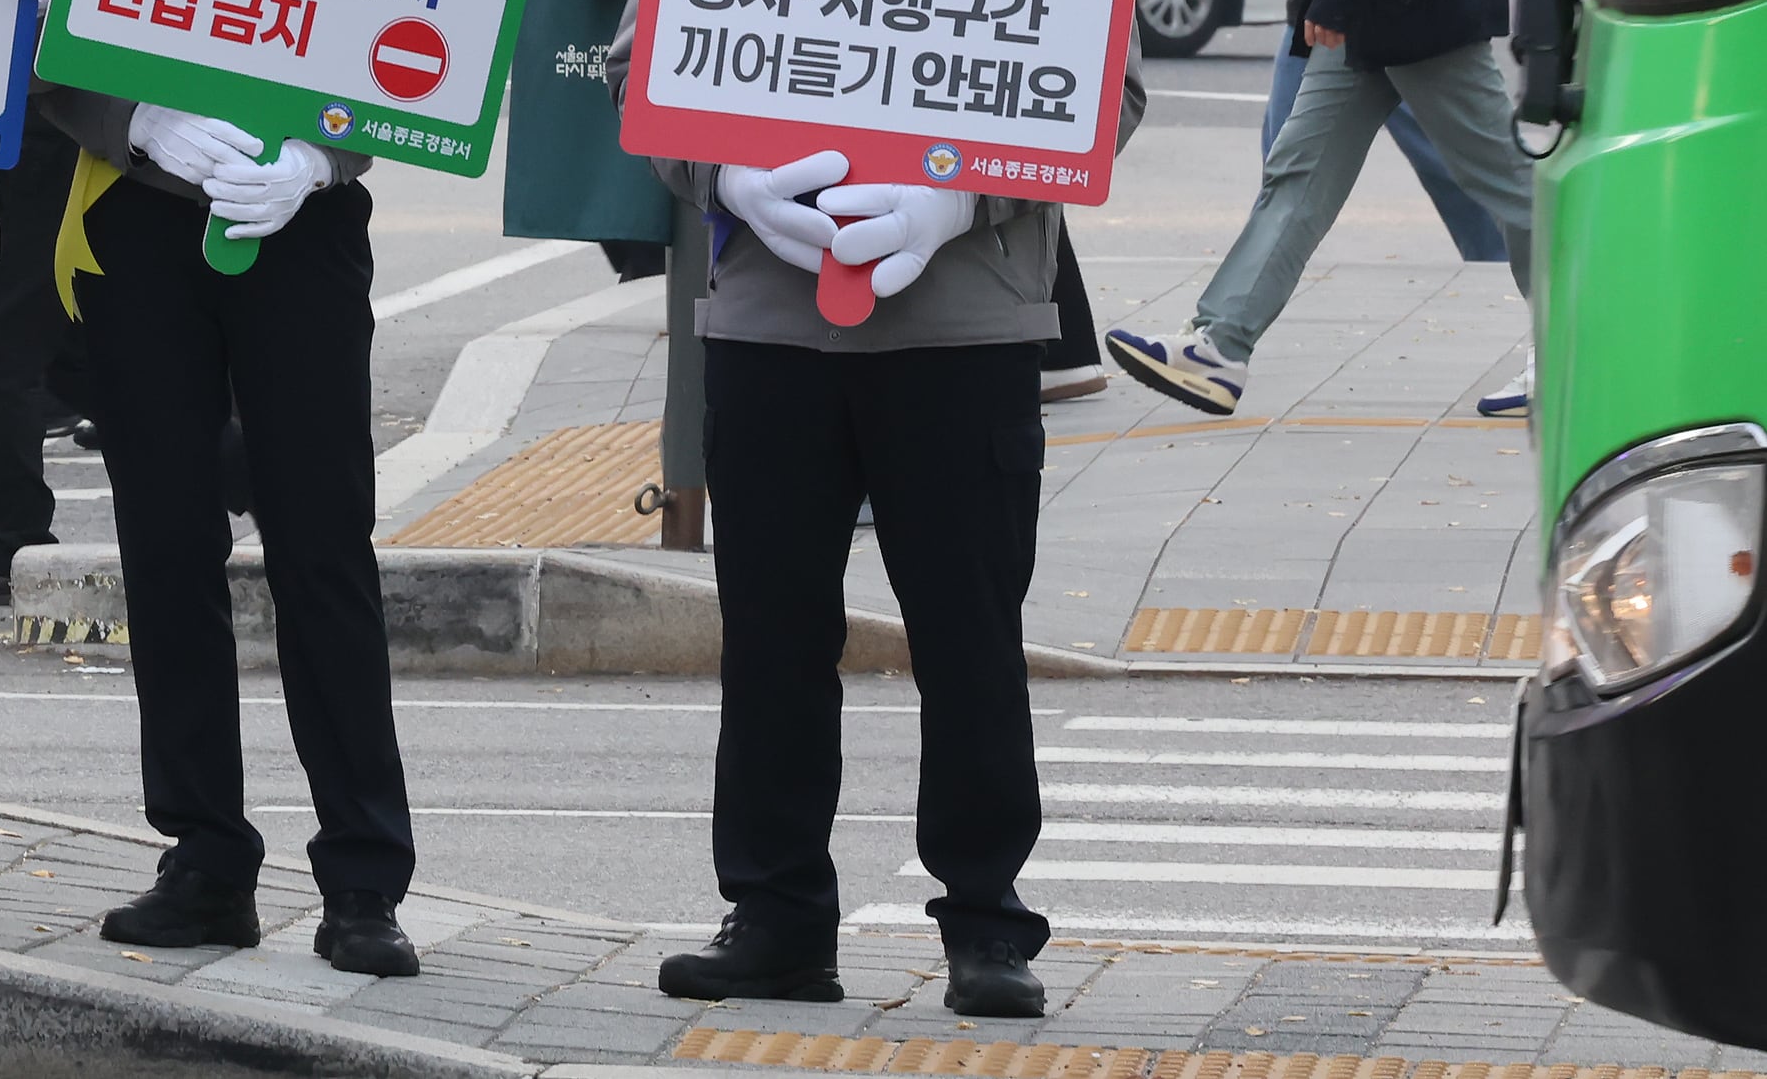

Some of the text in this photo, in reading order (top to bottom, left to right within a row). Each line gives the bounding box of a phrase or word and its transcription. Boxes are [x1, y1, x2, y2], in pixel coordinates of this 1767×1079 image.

[556, 44, 588, 63] 서울의
[556, 64, 584, 78] 다시
[673, 26, 1077, 123] 끼어들기 안돼요
[362, 119, 472, 160] 서울종로경찰서
[970, 157, 1089, 187] 서울종로경찰서
